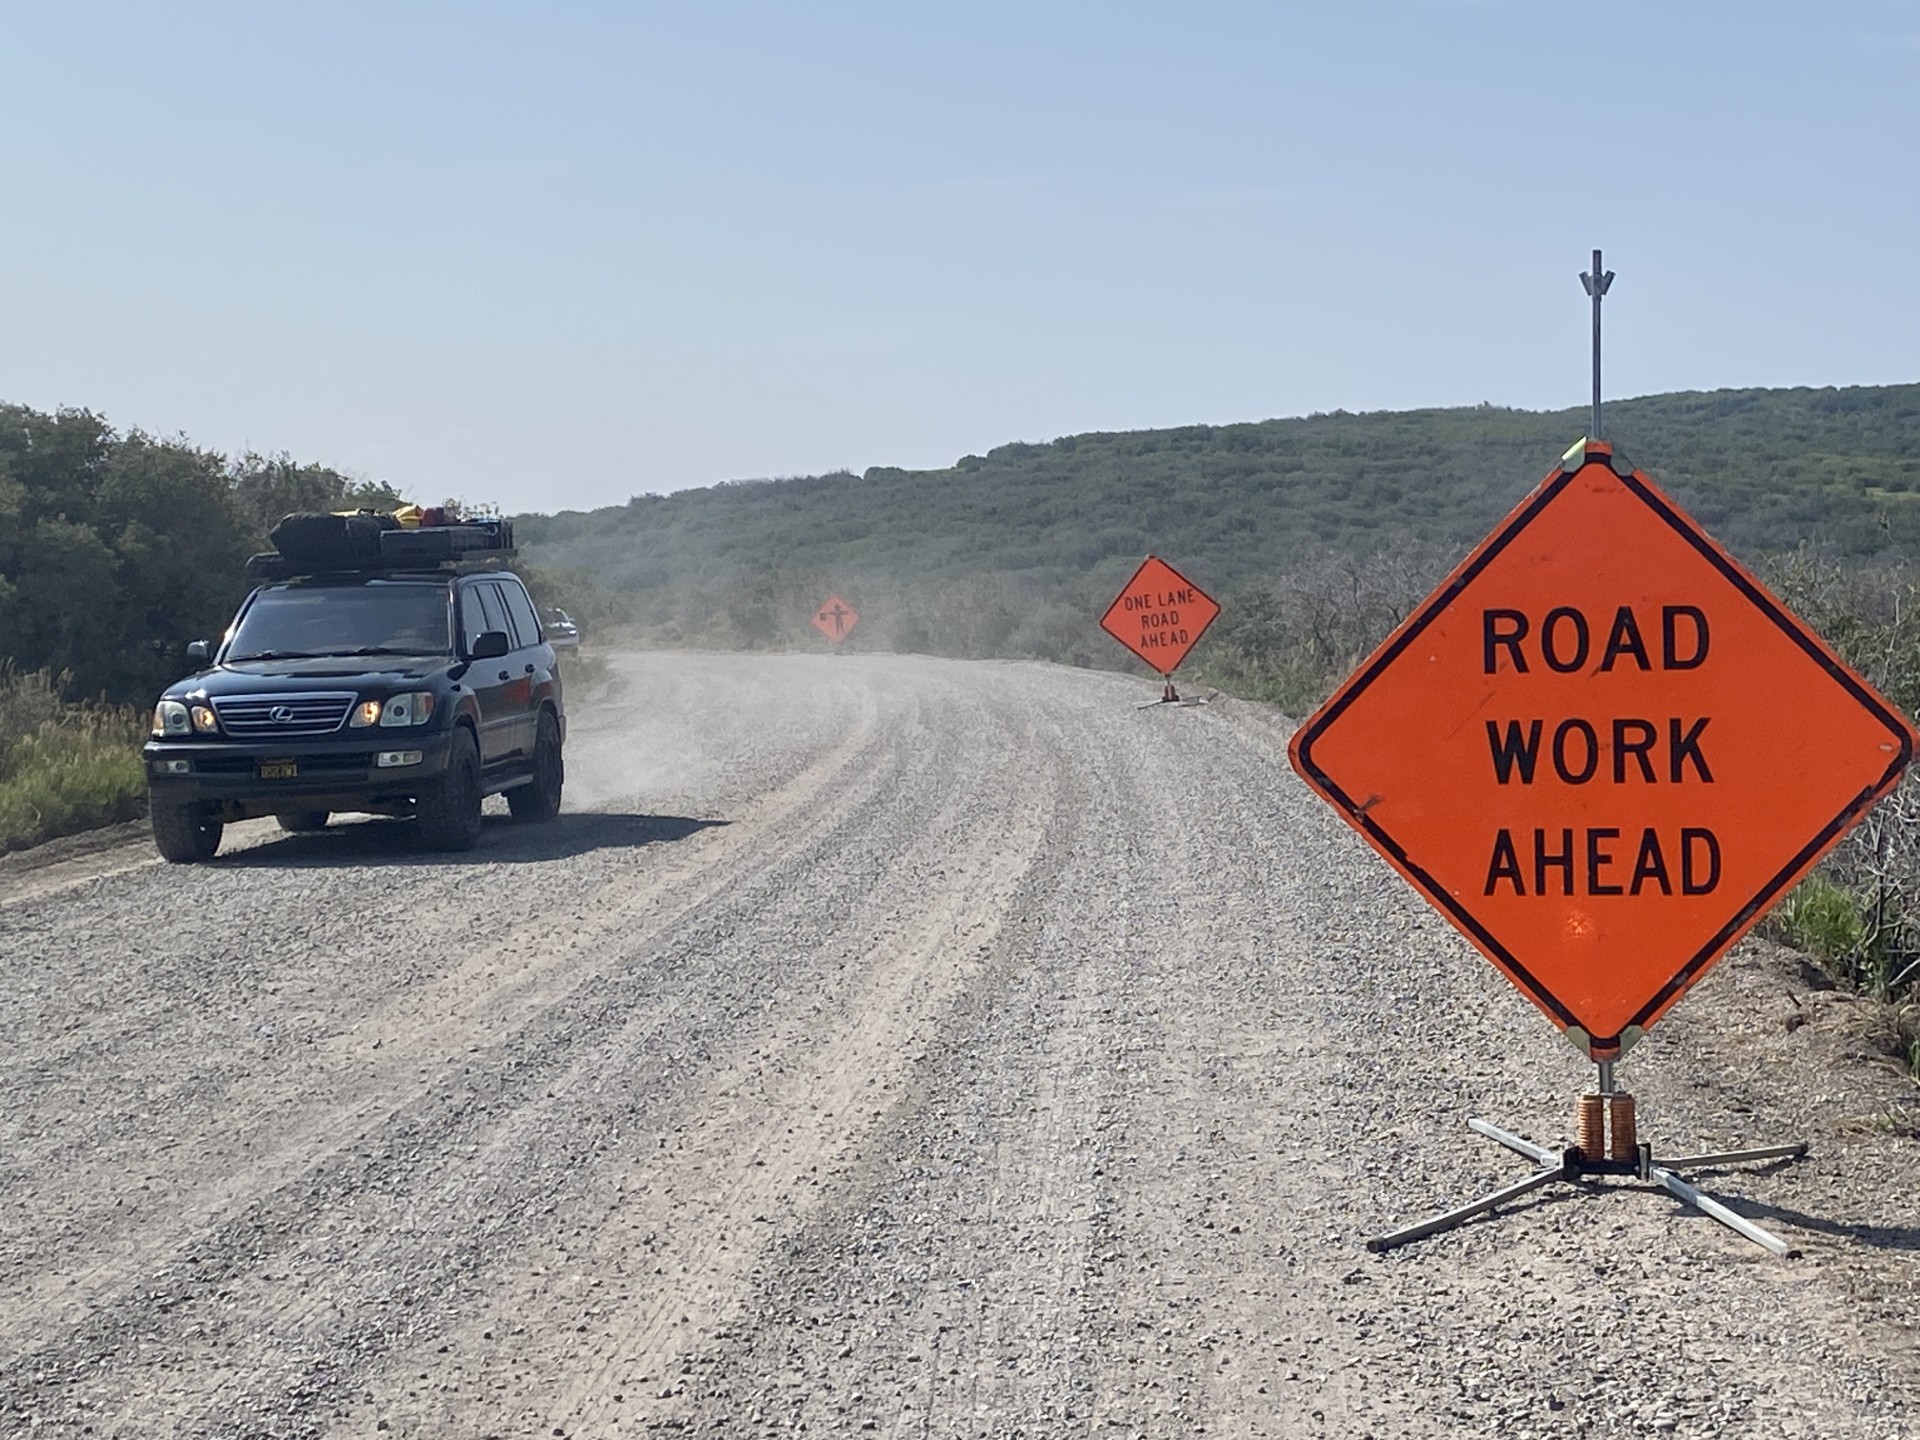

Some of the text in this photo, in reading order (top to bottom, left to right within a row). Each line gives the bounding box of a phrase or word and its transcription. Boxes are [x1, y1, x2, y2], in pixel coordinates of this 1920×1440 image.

[1125, 589, 1195, 611] ONE LANE
[1141, 610, 1179, 629] ROAD
[1141, 630, 1188, 648] AHEAD
[1483, 605, 1710, 674] ROAD
[1486, 717, 1714, 785] WORK
[1484, 828, 1721, 896] AHEAD
